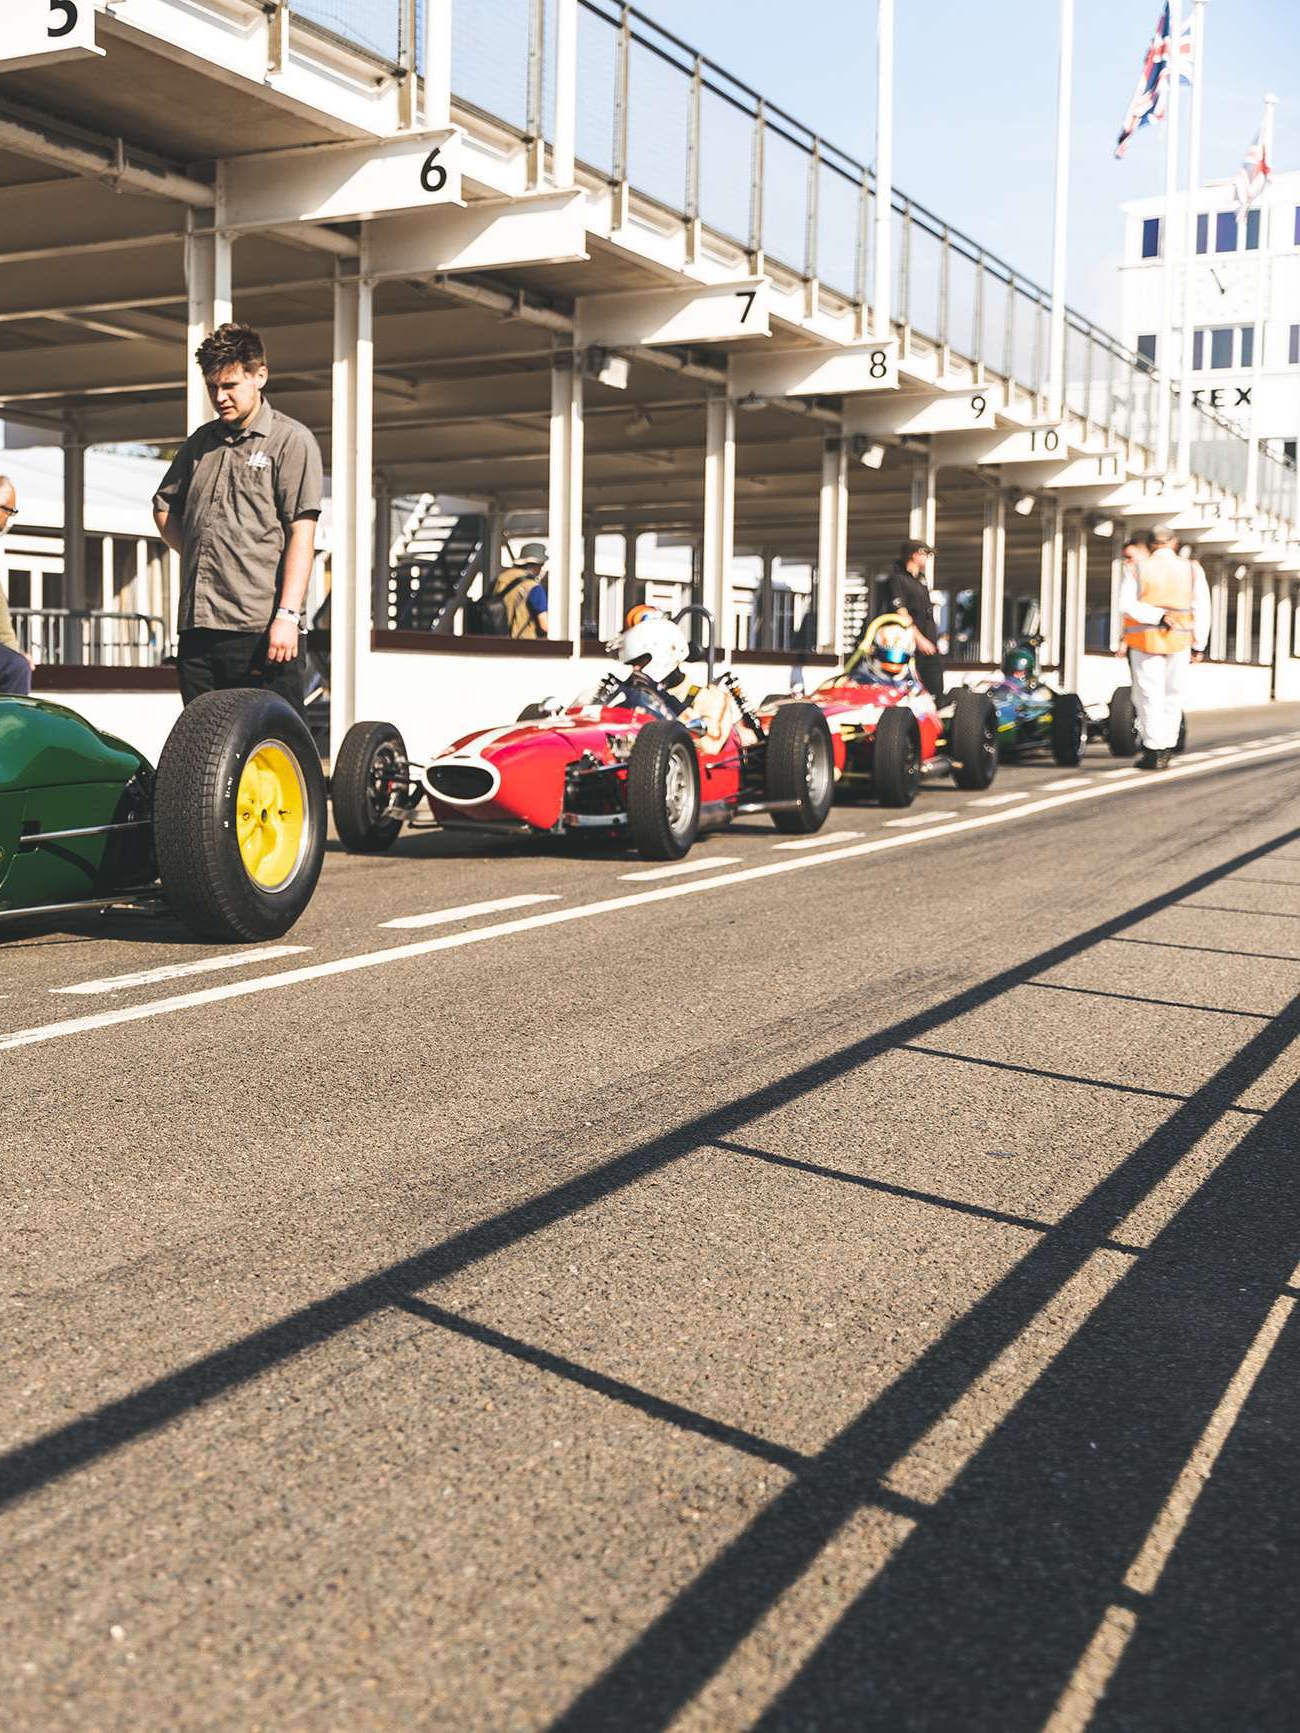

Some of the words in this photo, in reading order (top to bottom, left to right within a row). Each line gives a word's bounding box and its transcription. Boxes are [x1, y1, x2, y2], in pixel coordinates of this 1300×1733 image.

[47, 0, 78, 38] 5
[420, 147, 447, 192] 6
[735, 291, 757, 324] 7
[869, 350, 887, 379] 8
[971, 395, 986, 419] 9
[1031, 429, 1059, 451] 10
[1098, 457, 1118, 475] 11
[1142, 478, 1166, 497] 12
